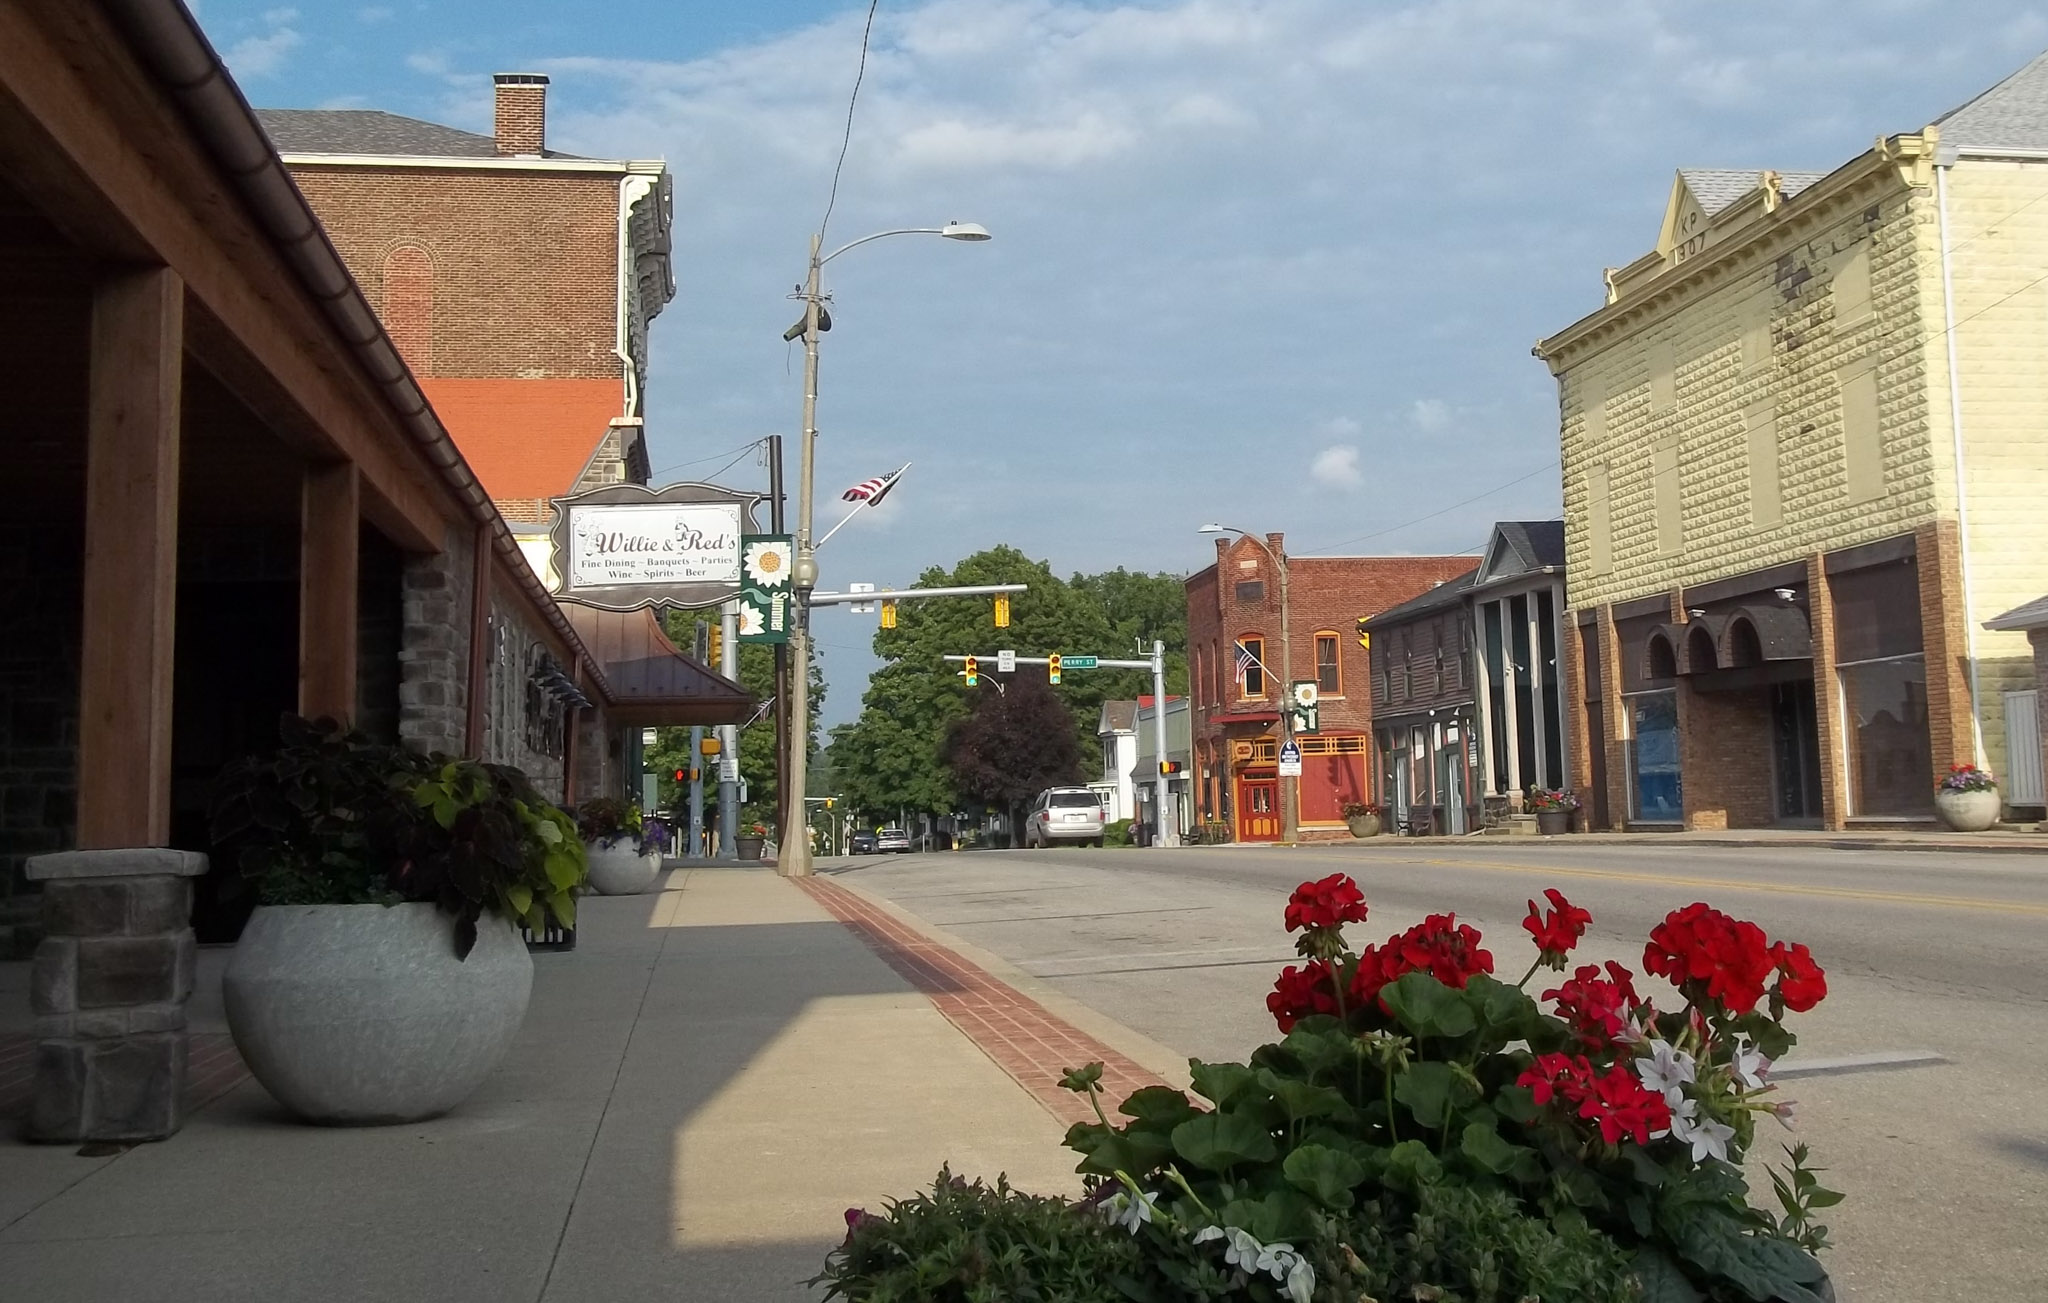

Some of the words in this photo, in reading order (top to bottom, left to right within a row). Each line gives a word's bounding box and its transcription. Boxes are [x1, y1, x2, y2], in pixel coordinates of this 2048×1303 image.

[595, 531, 658, 553] Willie
[662, 539, 674, 552] &
[681, 529, 736, 551] Red's
[581, 560, 602, 568] Fine
[604, 559, 636, 569] Dining
[647, 557, 690, 568] Banquets
[701, 555, 733, 565] Parties
[608, 570, 633, 579] Wine
[643, 569, 675, 580] Spirits
[685, 568, 706, 577] Beer
[771, 591, 789, 632] Summer
